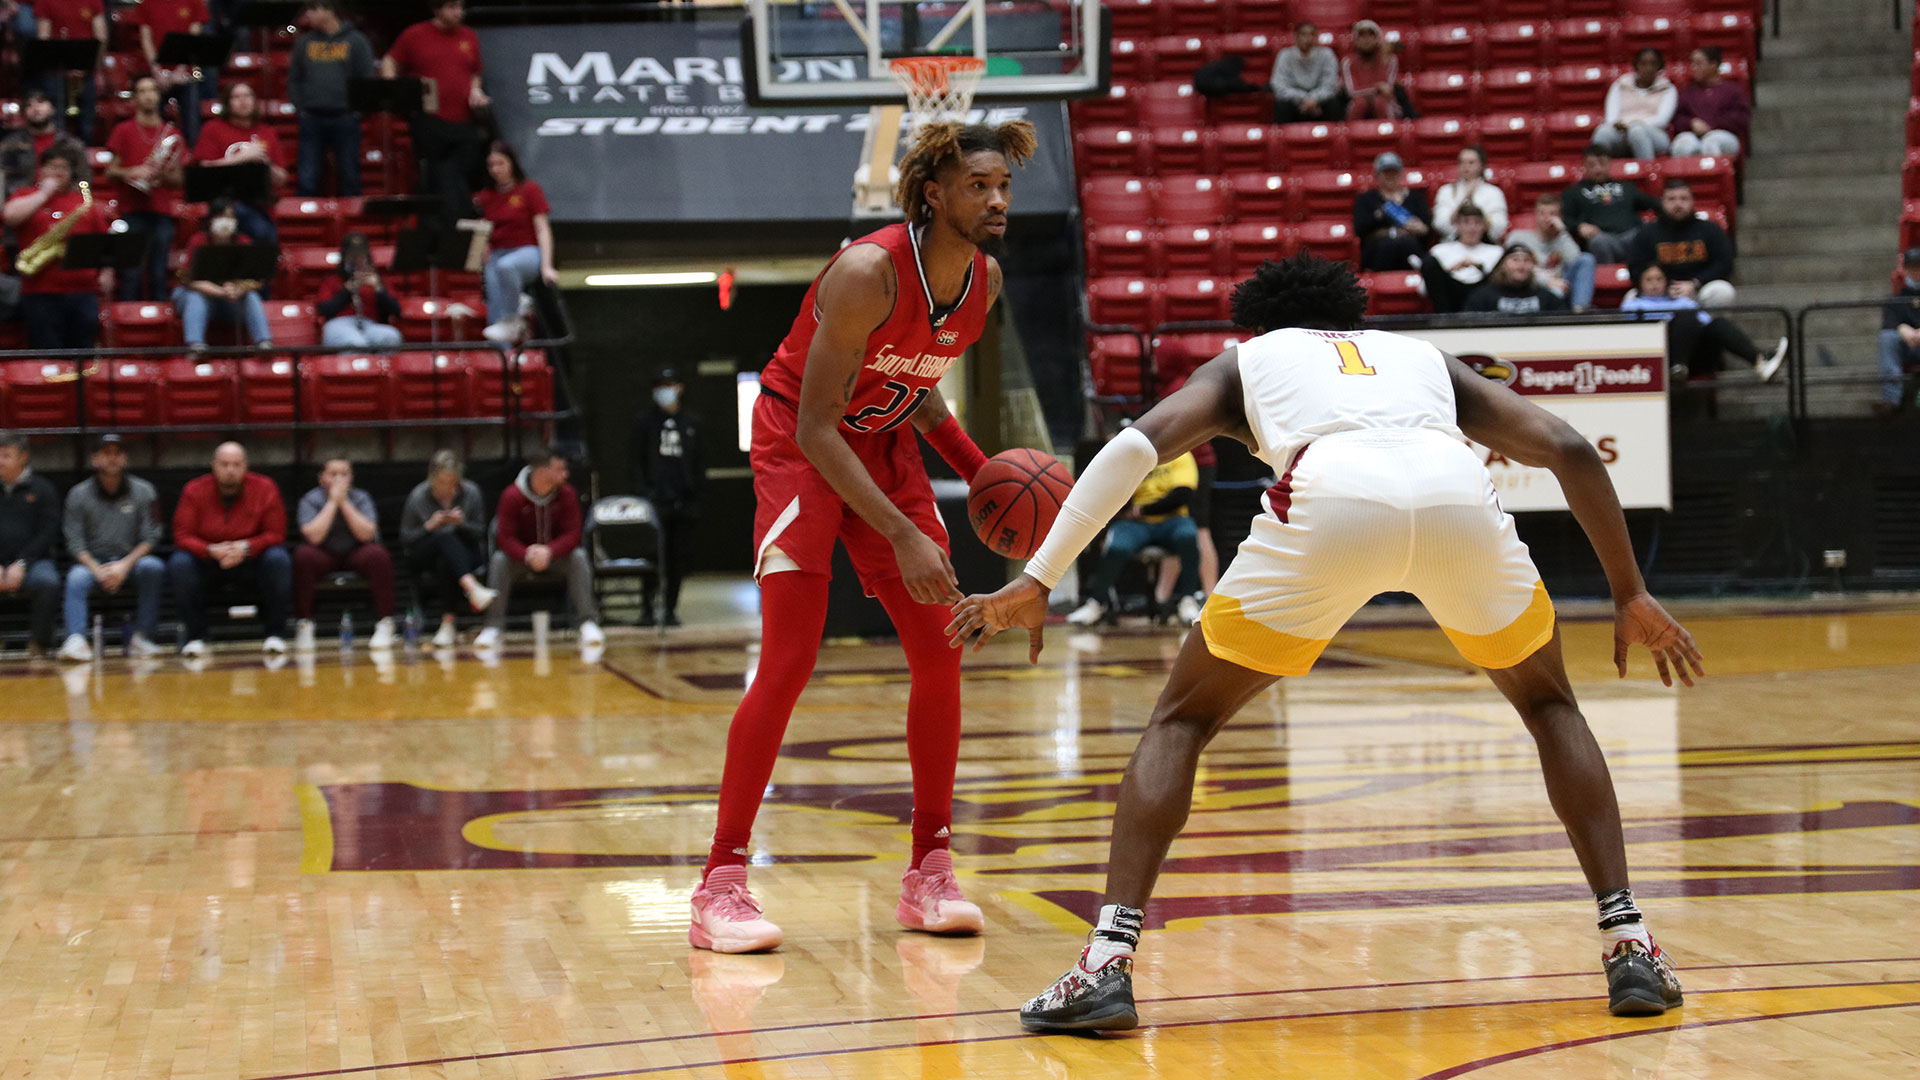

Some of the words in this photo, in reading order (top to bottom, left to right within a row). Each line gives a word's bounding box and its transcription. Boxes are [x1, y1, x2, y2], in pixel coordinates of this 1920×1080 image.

[528, 86, 691, 104] STATE
[537, 117, 841, 136] STUDENT
[1325, 340, 1377, 376] 1
[842, 380, 931, 434] 21
